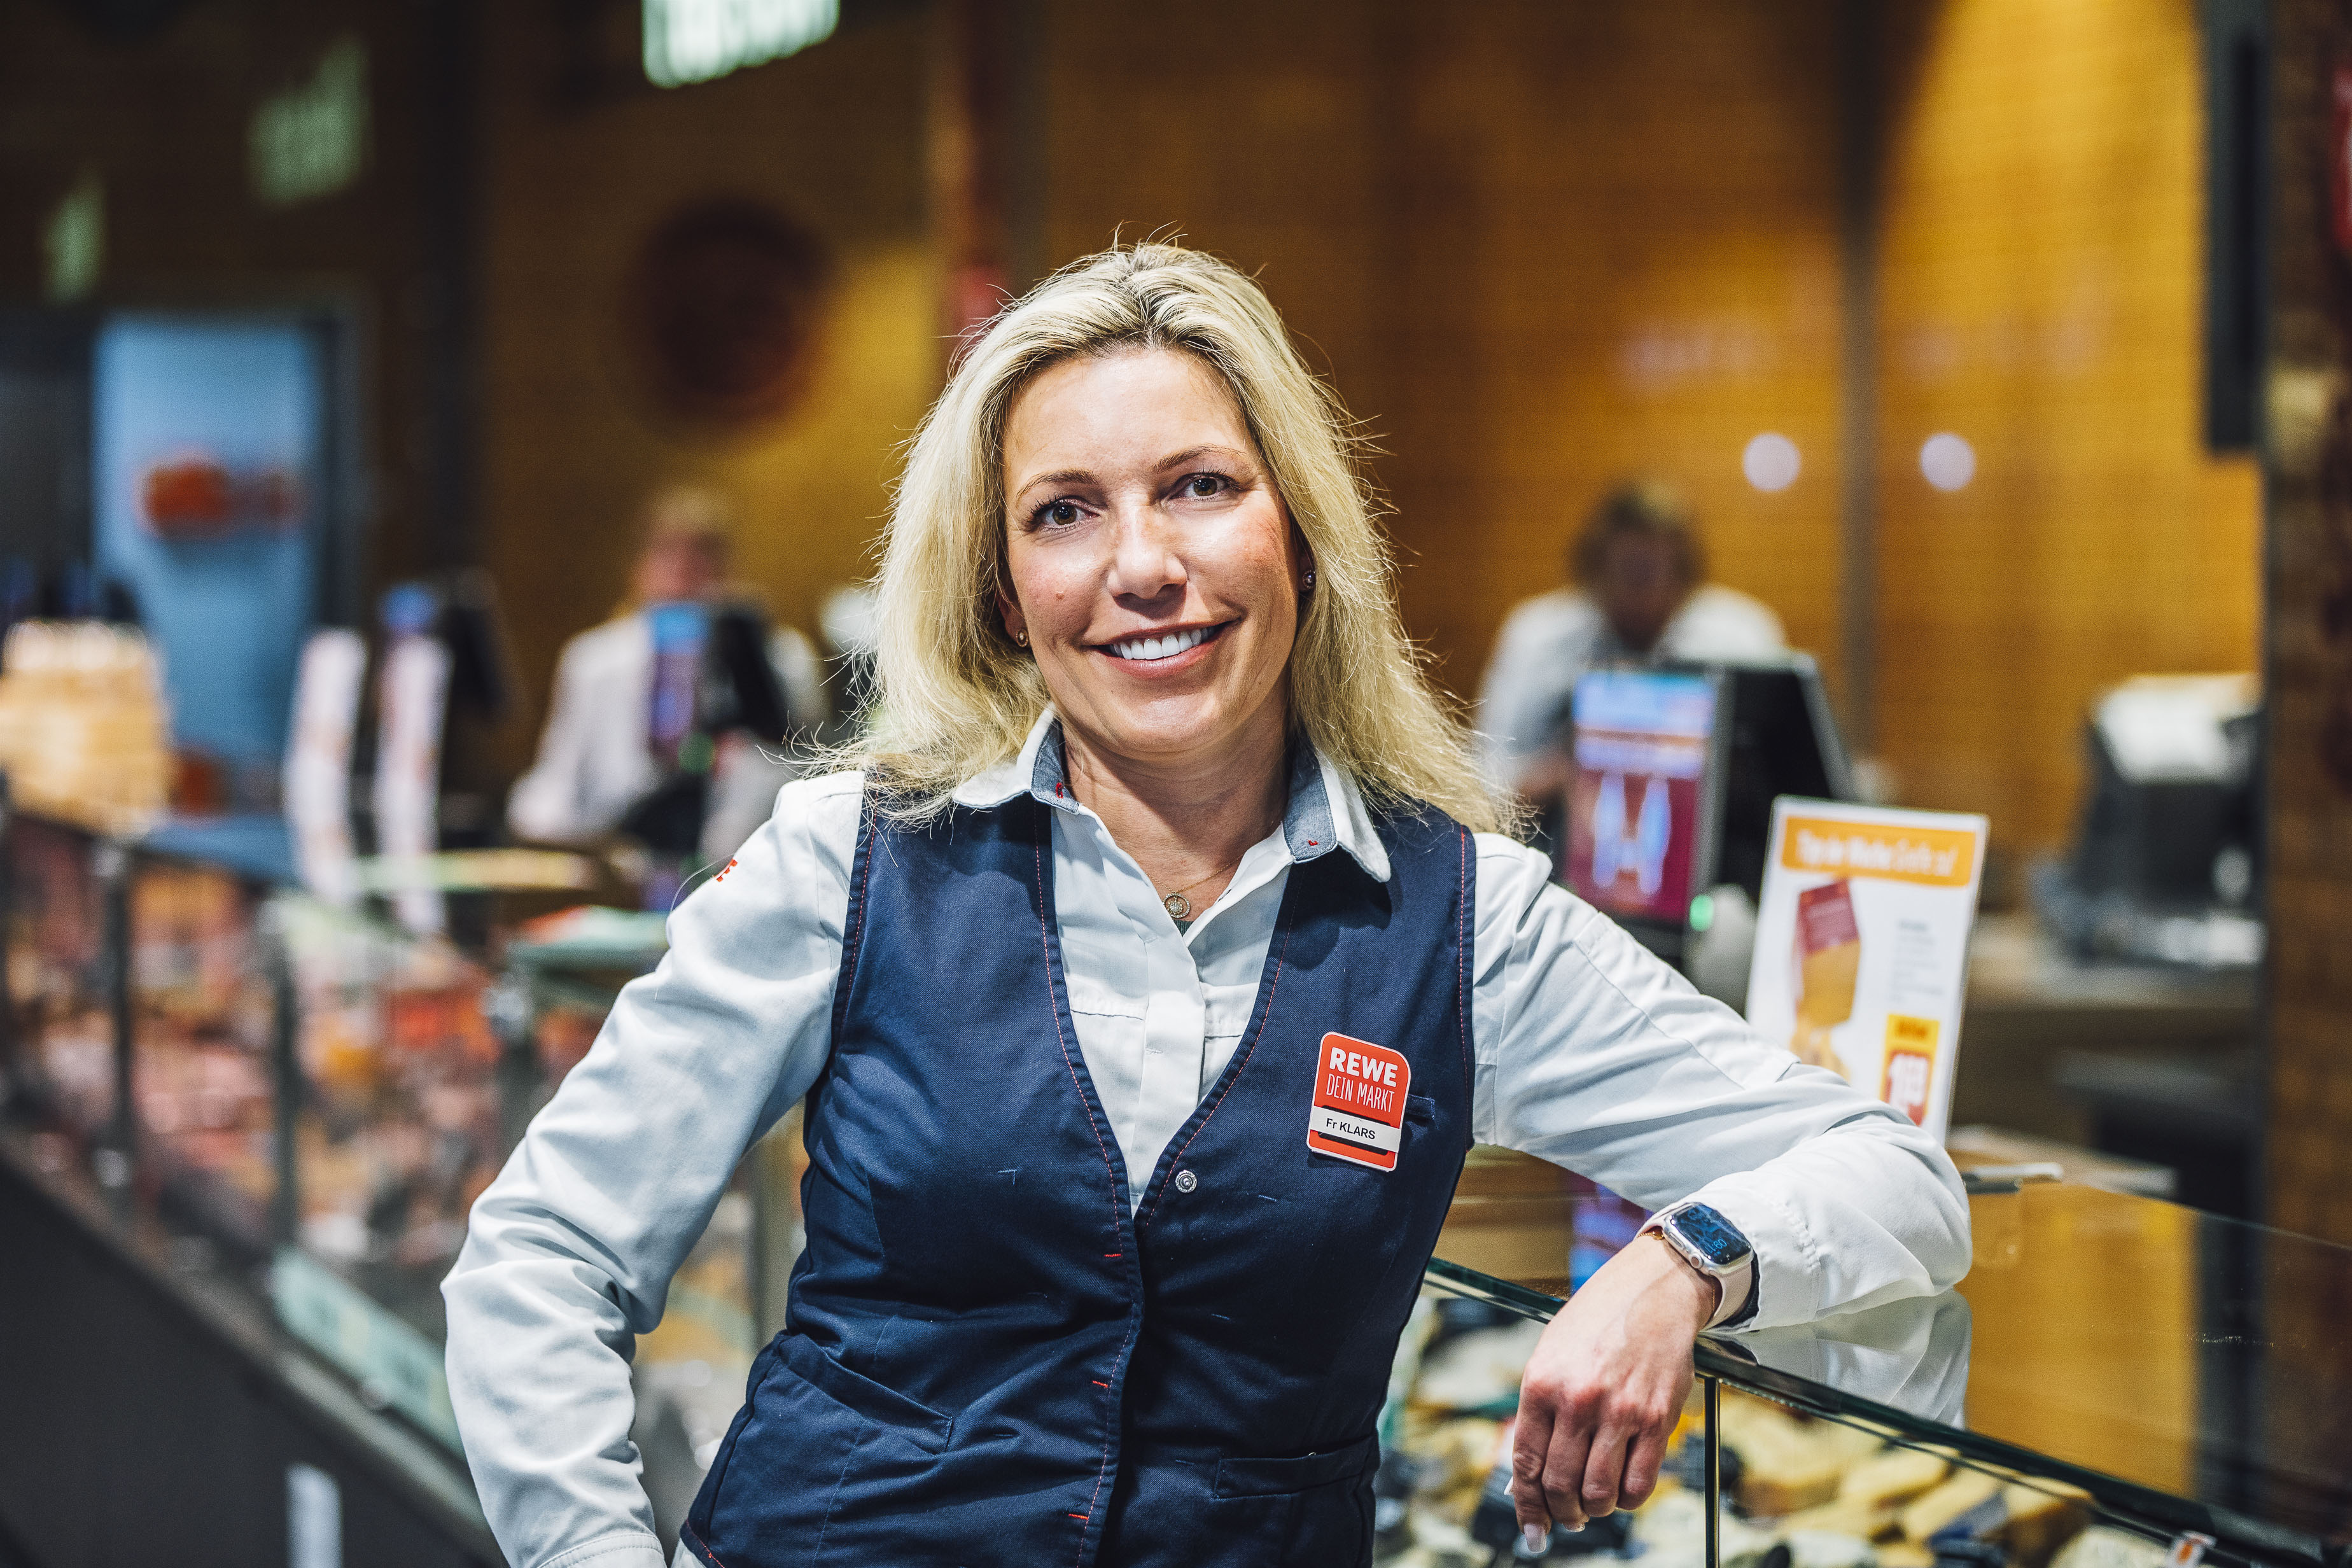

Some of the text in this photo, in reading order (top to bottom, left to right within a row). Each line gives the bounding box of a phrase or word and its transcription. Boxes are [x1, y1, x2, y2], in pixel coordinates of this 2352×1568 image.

[1329, 1047, 1398, 1088] REWE
[1326, 1074, 1395, 1113] DEIN MARKT
[1326, 1117, 1376, 1140] Fr KLARS
